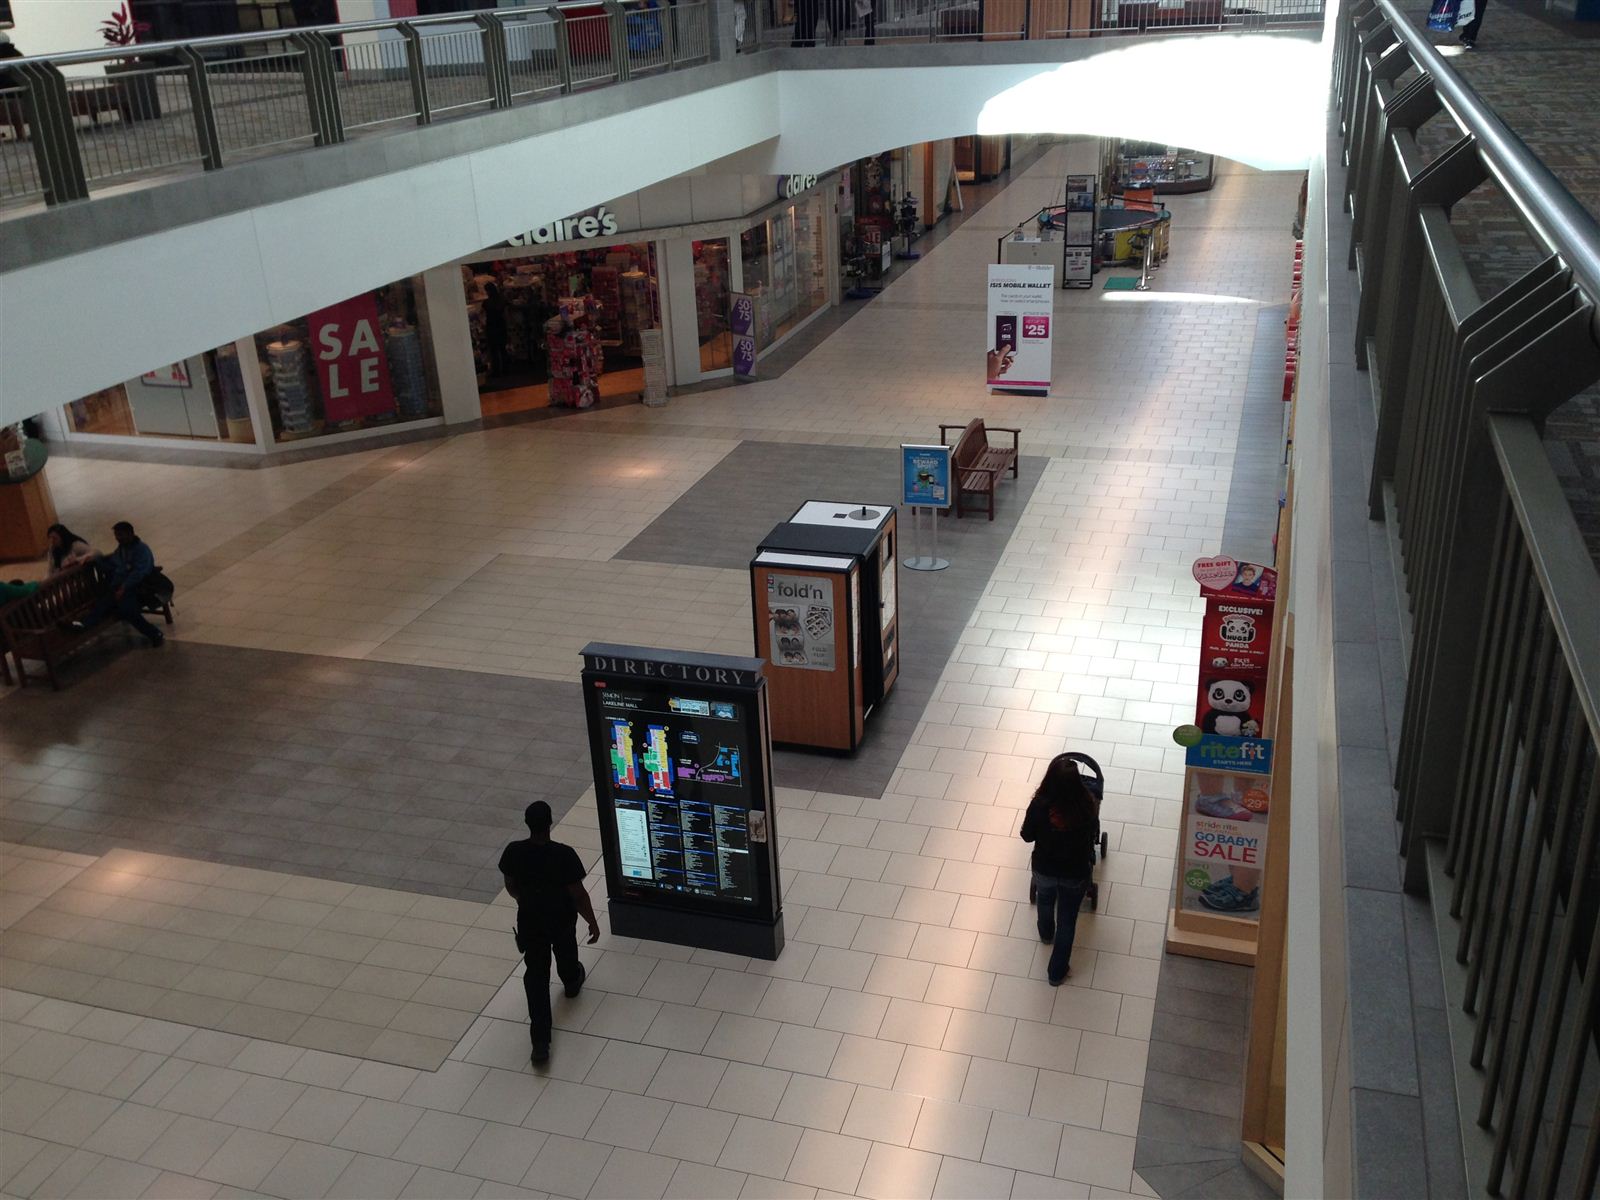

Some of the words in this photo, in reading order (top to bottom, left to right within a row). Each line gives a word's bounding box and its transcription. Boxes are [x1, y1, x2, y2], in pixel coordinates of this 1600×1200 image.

[777, 582, 823, 600] fold'n
[1218, 605, 1263, 615] EXCLUSIVE!
[594, 656, 744, 685] DIRECTORY
[1196, 820, 1221, 830] stride
[1195, 831, 1216, 842] GO
[1217, 834, 1258, 847] BABY!
[1194, 841, 1258, 864] SALE
